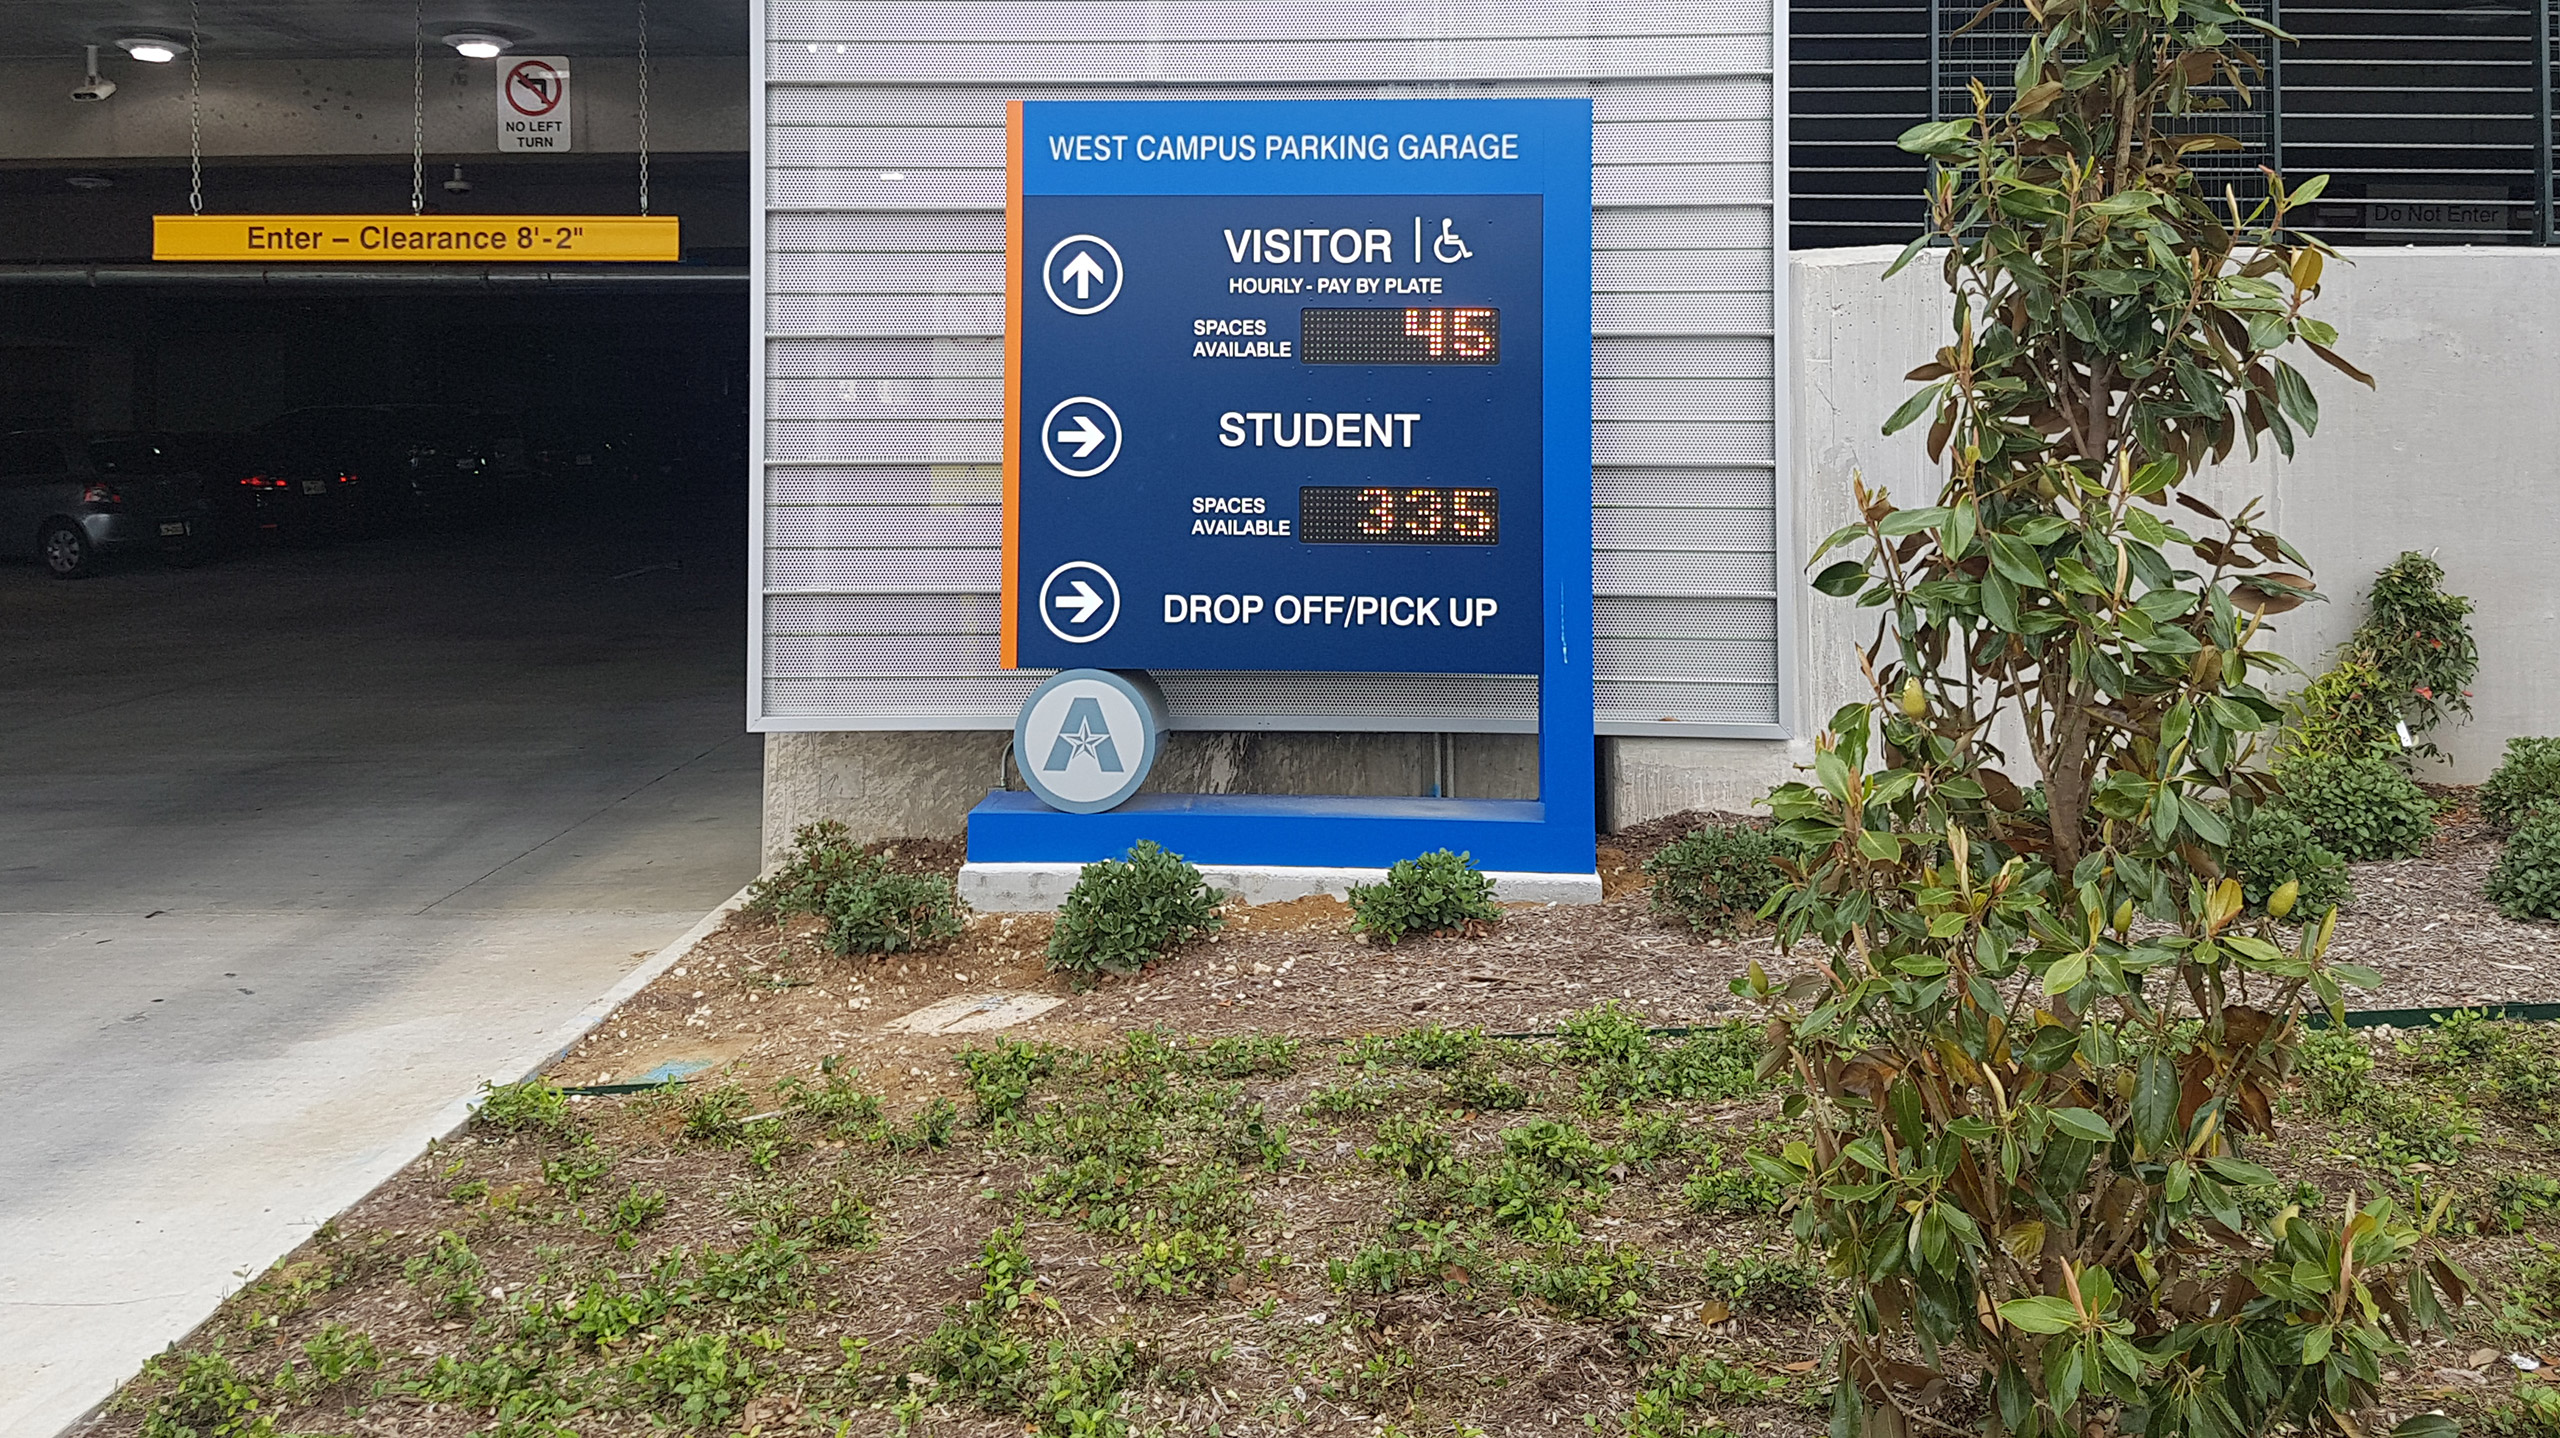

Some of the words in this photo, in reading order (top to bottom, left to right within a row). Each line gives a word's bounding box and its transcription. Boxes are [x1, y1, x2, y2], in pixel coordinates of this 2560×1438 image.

[506, 122, 525, 131] NO
[529, 122, 562, 131] LEFT
[517, 137, 553, 147] TURN
[1049, 136, 1128, 161] WEST
[1136, 135, 1256, 161] CAMPUS
[1266, 134, 1389, 160] PARKING
[1397, 133, 1519, 160] GARAGE
[2374, 205, 2401, 221] Do
[2408, 205, 2440, 221] Not
[2448, 205, 2498, 222] Enter
[248, 226, 323, 249] Enter
[360, 226, 506, 250] Clearance
[517, 227, 583, 249] 8'-2"
[1223, 229, 1392, 264] VISITOR
[1229, 278, 1304, 294] HOURLY
[1317, 278, 1351, 294] PAY
[1356, 278, 1380, 294] BY
[1385, 278, 1443, 294] PLATE
[1193, 320, 1267, 336] SPACES
[1404, 309, 1492, 357] 45
[1193, 342, 1292, 358] AVAILABLE
[1219, 412, 1421, 448] STUDENT
[1192, 497, 1266, 514] SPACES
[1356, 490, 1492, 536] 335
[1191, 519, 1291, 536] AVAILABLE
[1164, 594, 1264, 625] DROP
[1274, 595, 1441, 629] OFF/PICK
[1449, 598, 1498, 627] UP
